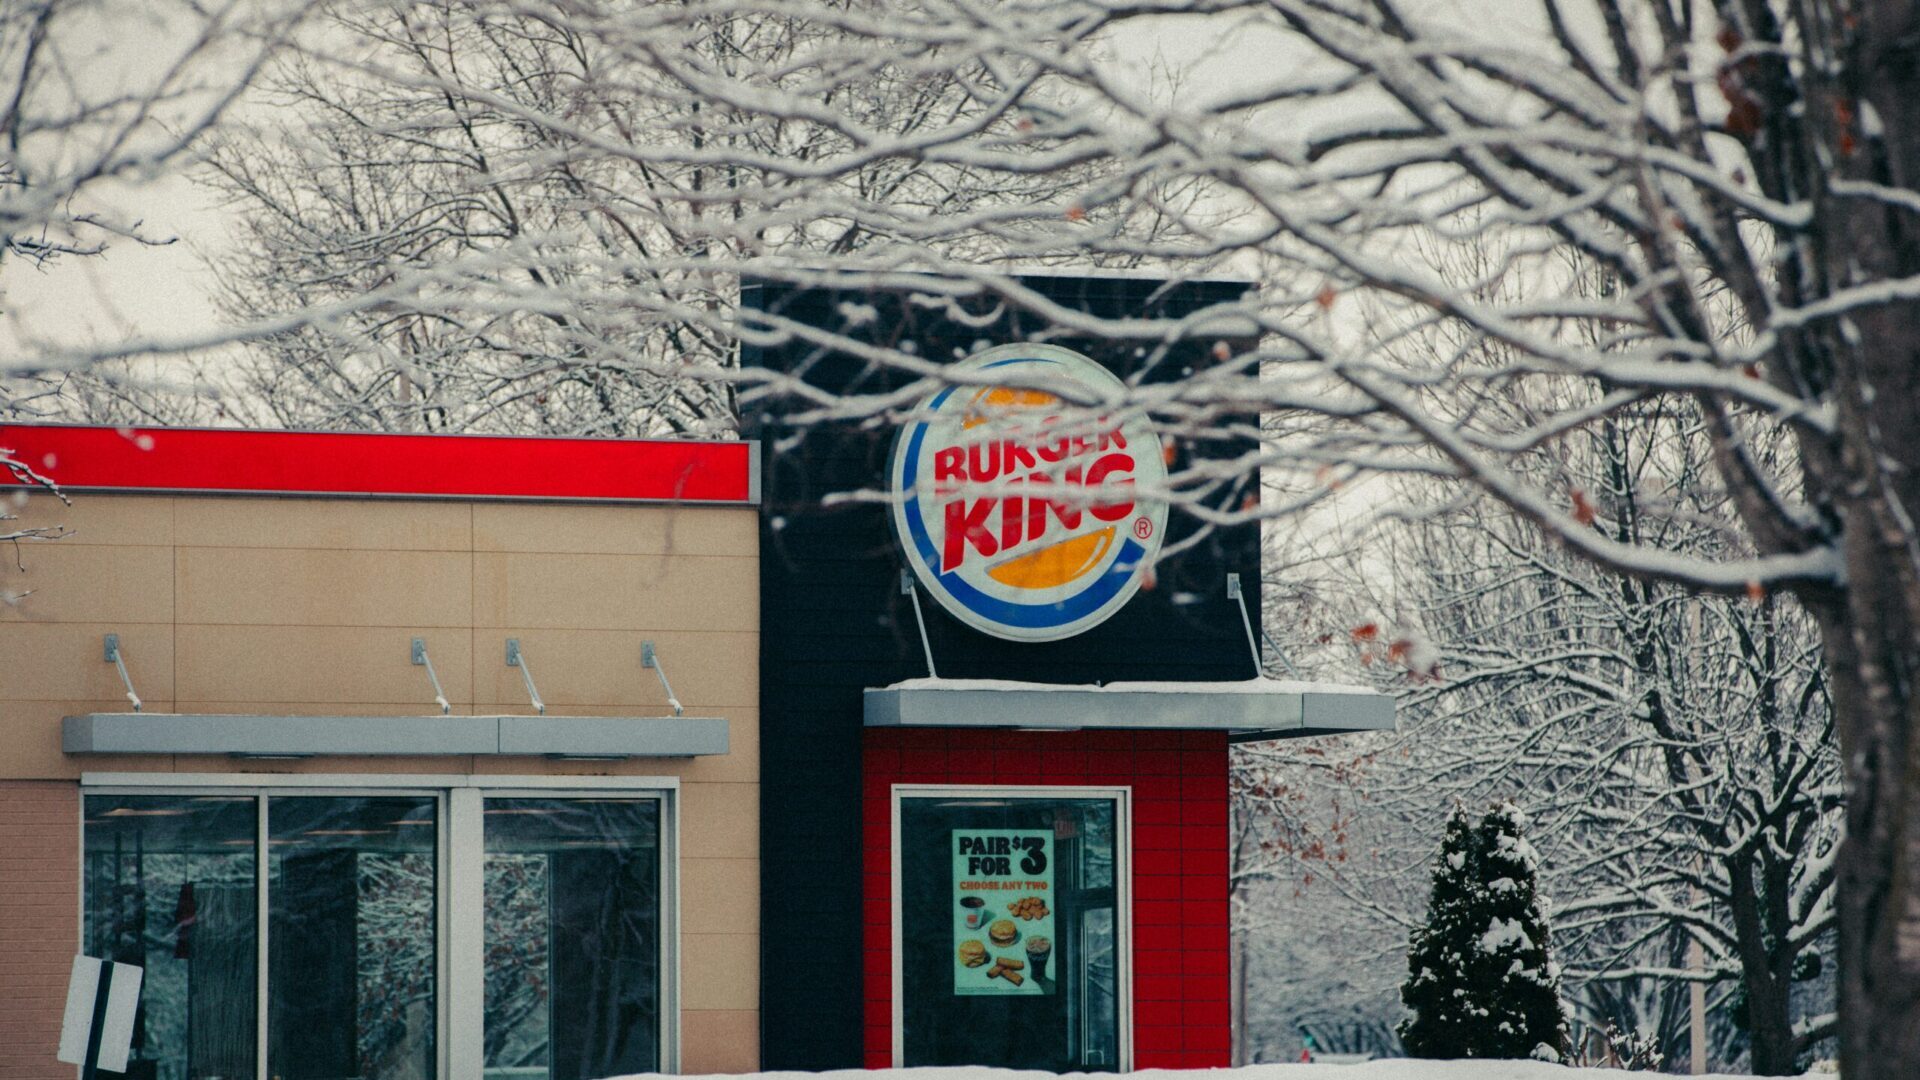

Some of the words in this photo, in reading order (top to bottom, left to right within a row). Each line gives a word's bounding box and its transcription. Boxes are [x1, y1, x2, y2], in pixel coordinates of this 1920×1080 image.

[942, 453, 1136, 573] KING
[959, 836, 1011, 855] PAIR
[1012, 835, 1047, 875] $3
[968, 857, 1011, 876] FOR
[959, 881, 999, 890] CHOOSE
[1002, 881, 1023, 890] ANY
[1025, 881, 1048, 890] TWO
